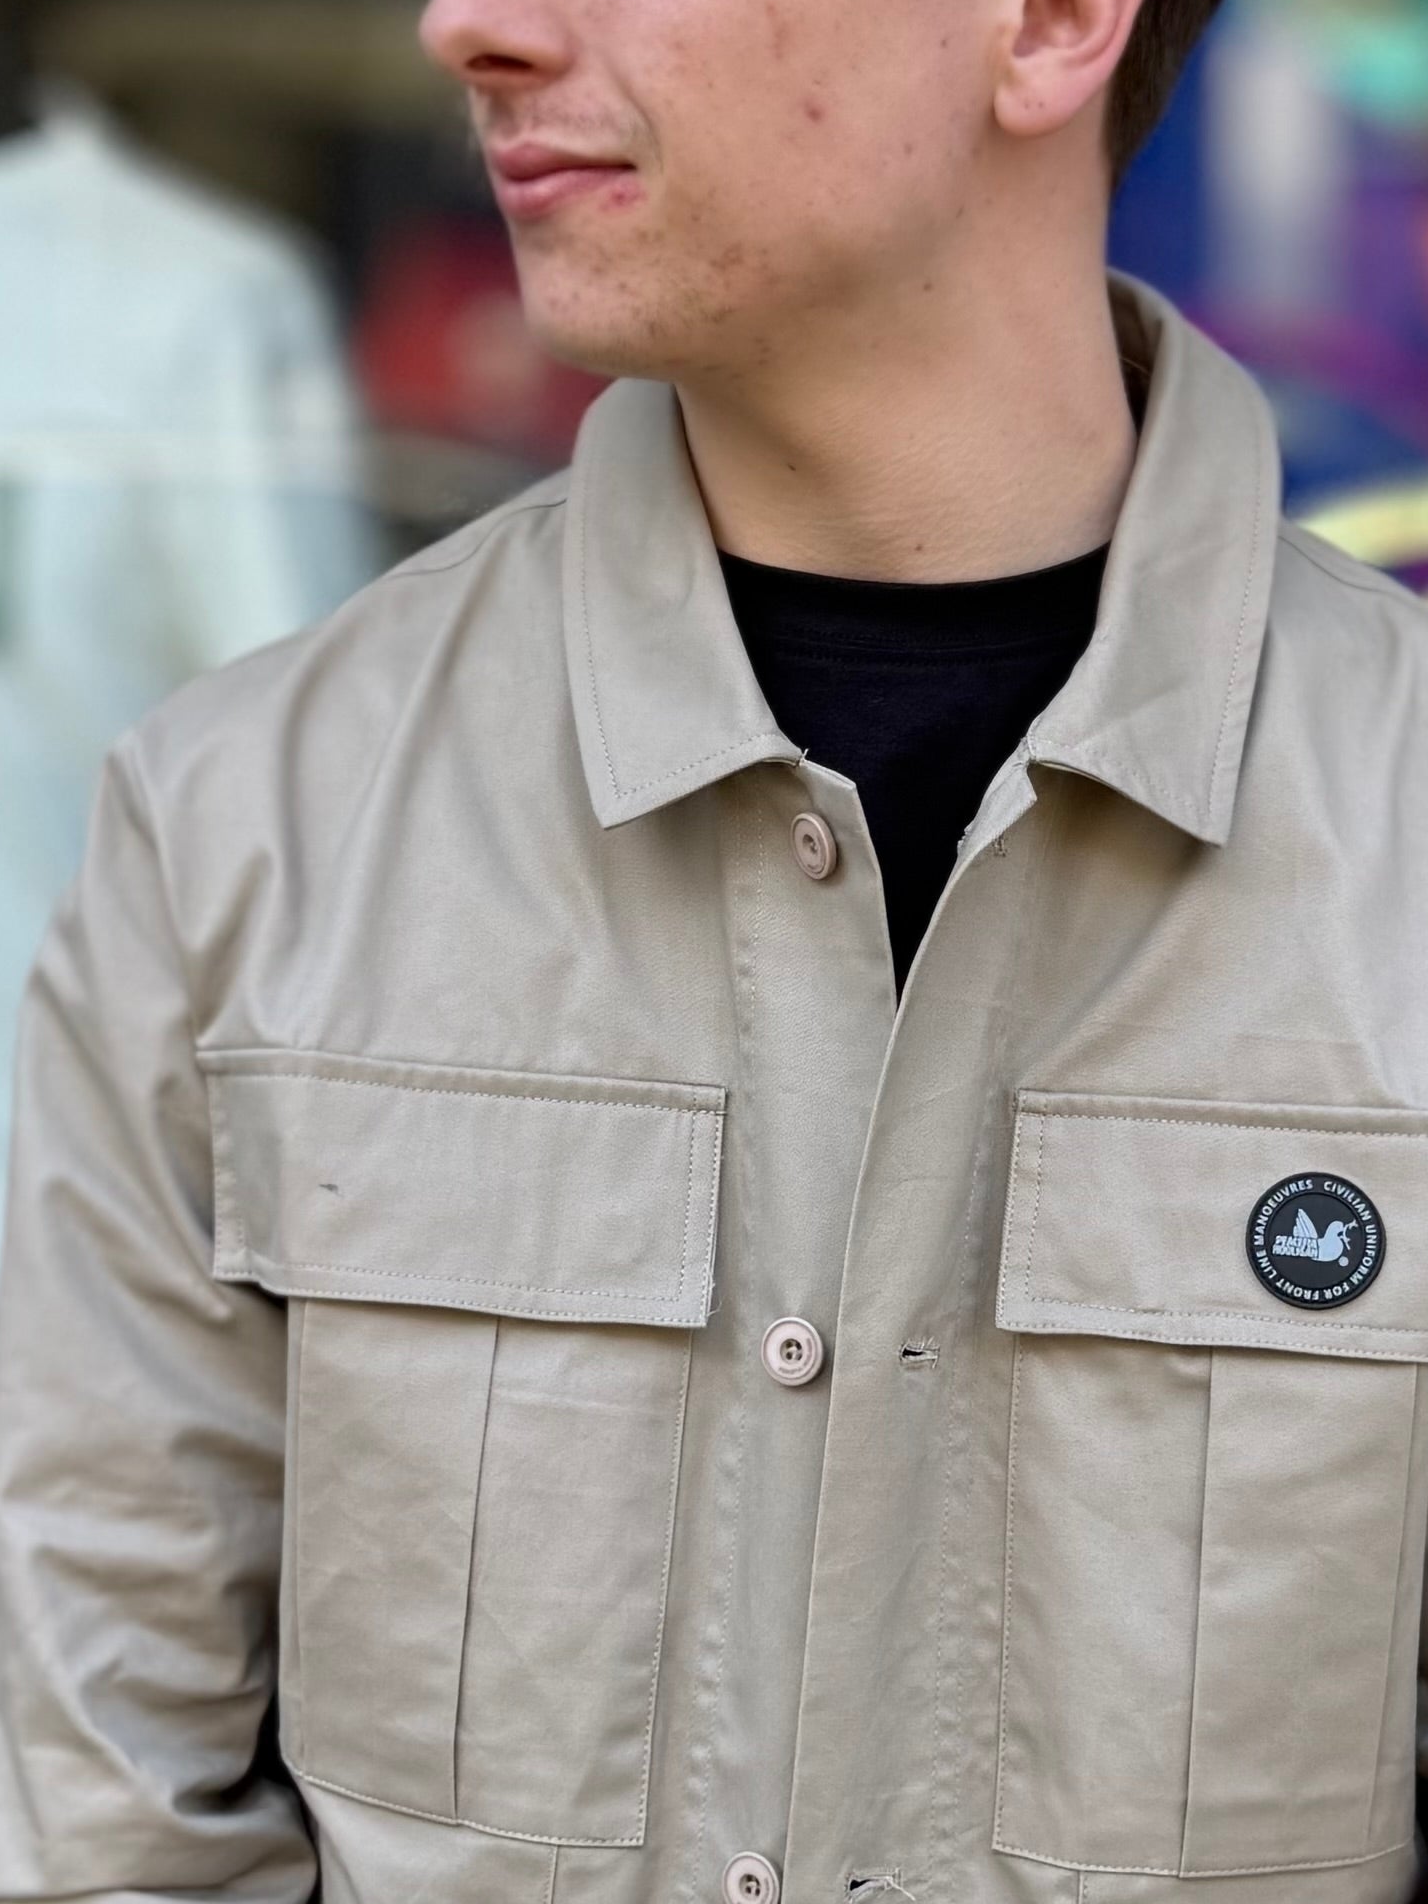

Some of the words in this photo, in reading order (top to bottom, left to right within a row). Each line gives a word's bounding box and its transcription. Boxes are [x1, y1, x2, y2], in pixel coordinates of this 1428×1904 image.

[1254, 1179, 1314, 1246] MANOEUVRES
[1323, 1181, 1372, 1220] CIVILIAN
[1256, 1249, 1278, 1279] LINE
[1350, 1224, 1377, 1285] UNIFORM
[1275, 1278, 1321, 1300] FRONT
[1323, 1282, 1350, 1299] FOR
